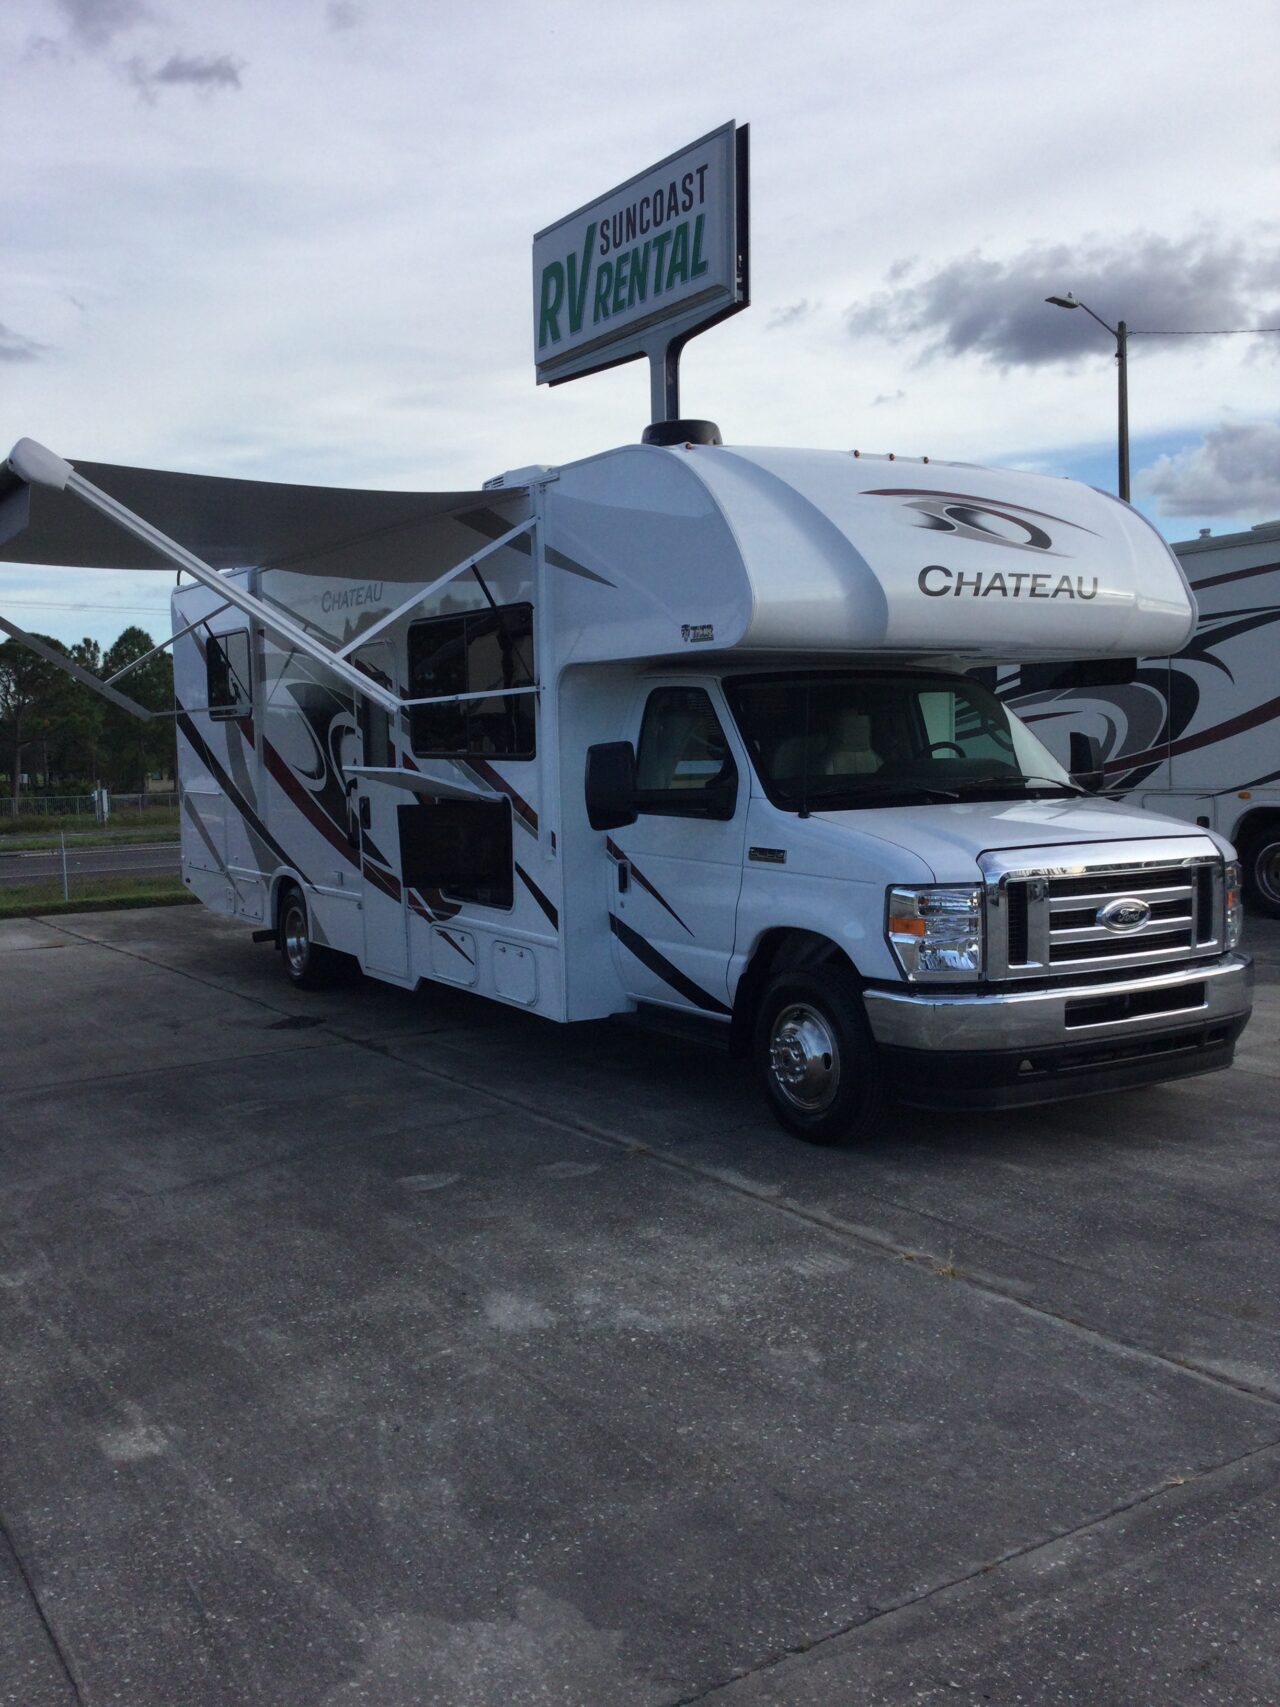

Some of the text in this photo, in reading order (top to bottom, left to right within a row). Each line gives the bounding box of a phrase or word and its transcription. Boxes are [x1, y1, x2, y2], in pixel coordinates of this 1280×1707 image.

[600, 163, 708, 256] SUNCOAST
[538, 212, 709, 348] RV RENTAL
[321, 582, 384, 613] CHATEAU
[918, 565, 1099, 600] CHATEAU
